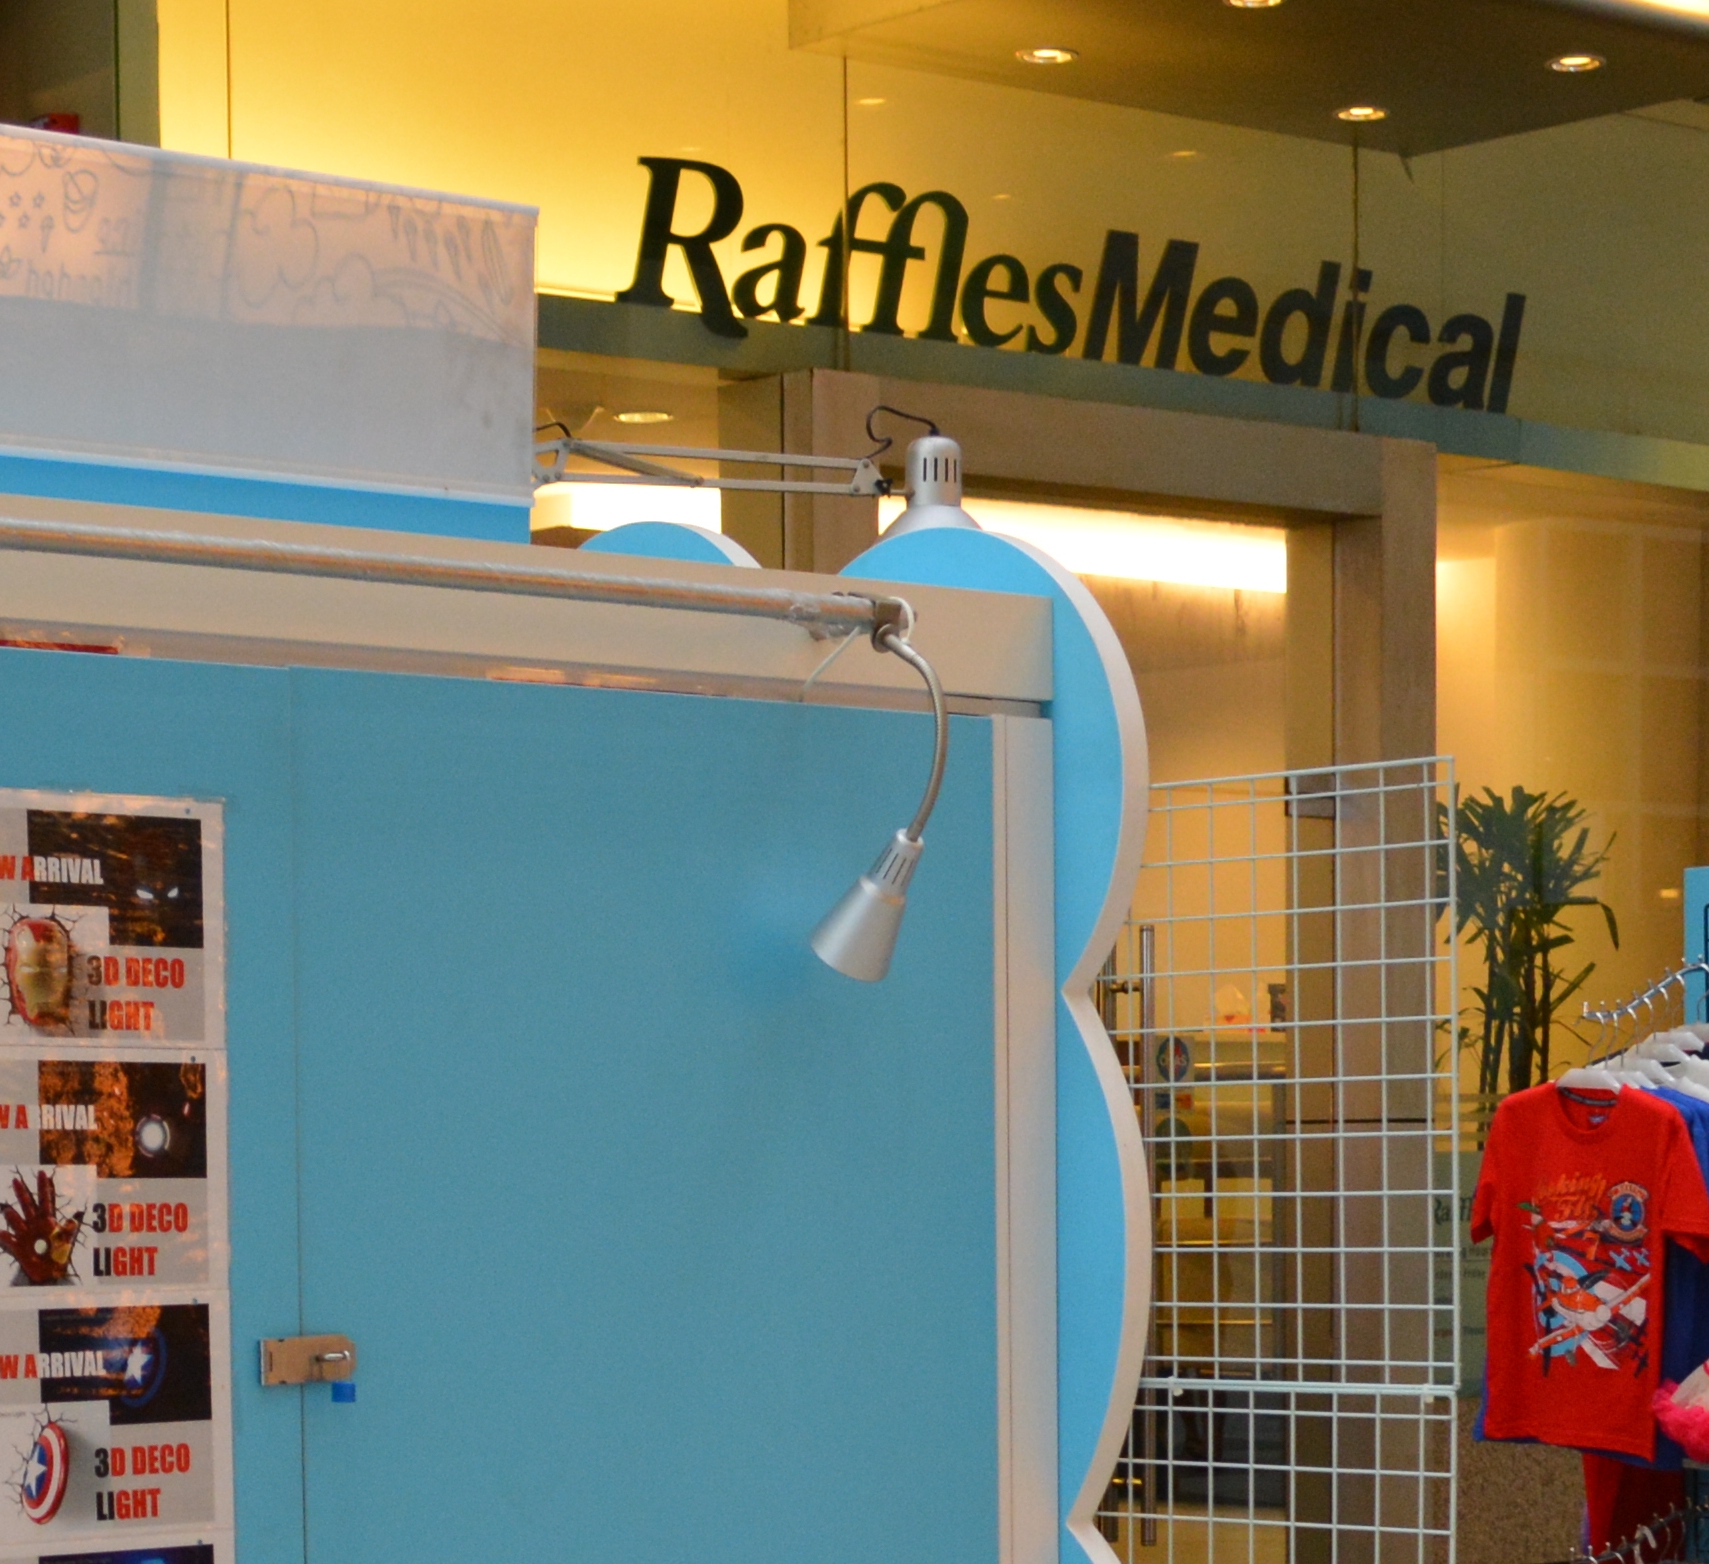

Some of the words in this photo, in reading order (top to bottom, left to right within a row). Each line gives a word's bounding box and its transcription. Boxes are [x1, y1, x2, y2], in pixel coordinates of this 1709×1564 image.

[21, 855, 104, 885] ARRIVAL
[87, 955, 119, 987] 3D
[125, 957, 185, 988] DECO
[88, 1000, 155, 1030] LIGHT
[15, 1104, 98, 1130] ARIVAL
[92, 1203, 124, 1233] 3D
[130, 1203, 188, 1233] DECO
[93, 1246, 158, 1276] LIGHT
[24, 1350, 107, 1379] ARRIVAL
[94, 1447, 125, 1478] 3D
[132, 1443, 190, 1476] DECO
[96, 1488, 161, 1521] LIGHT
